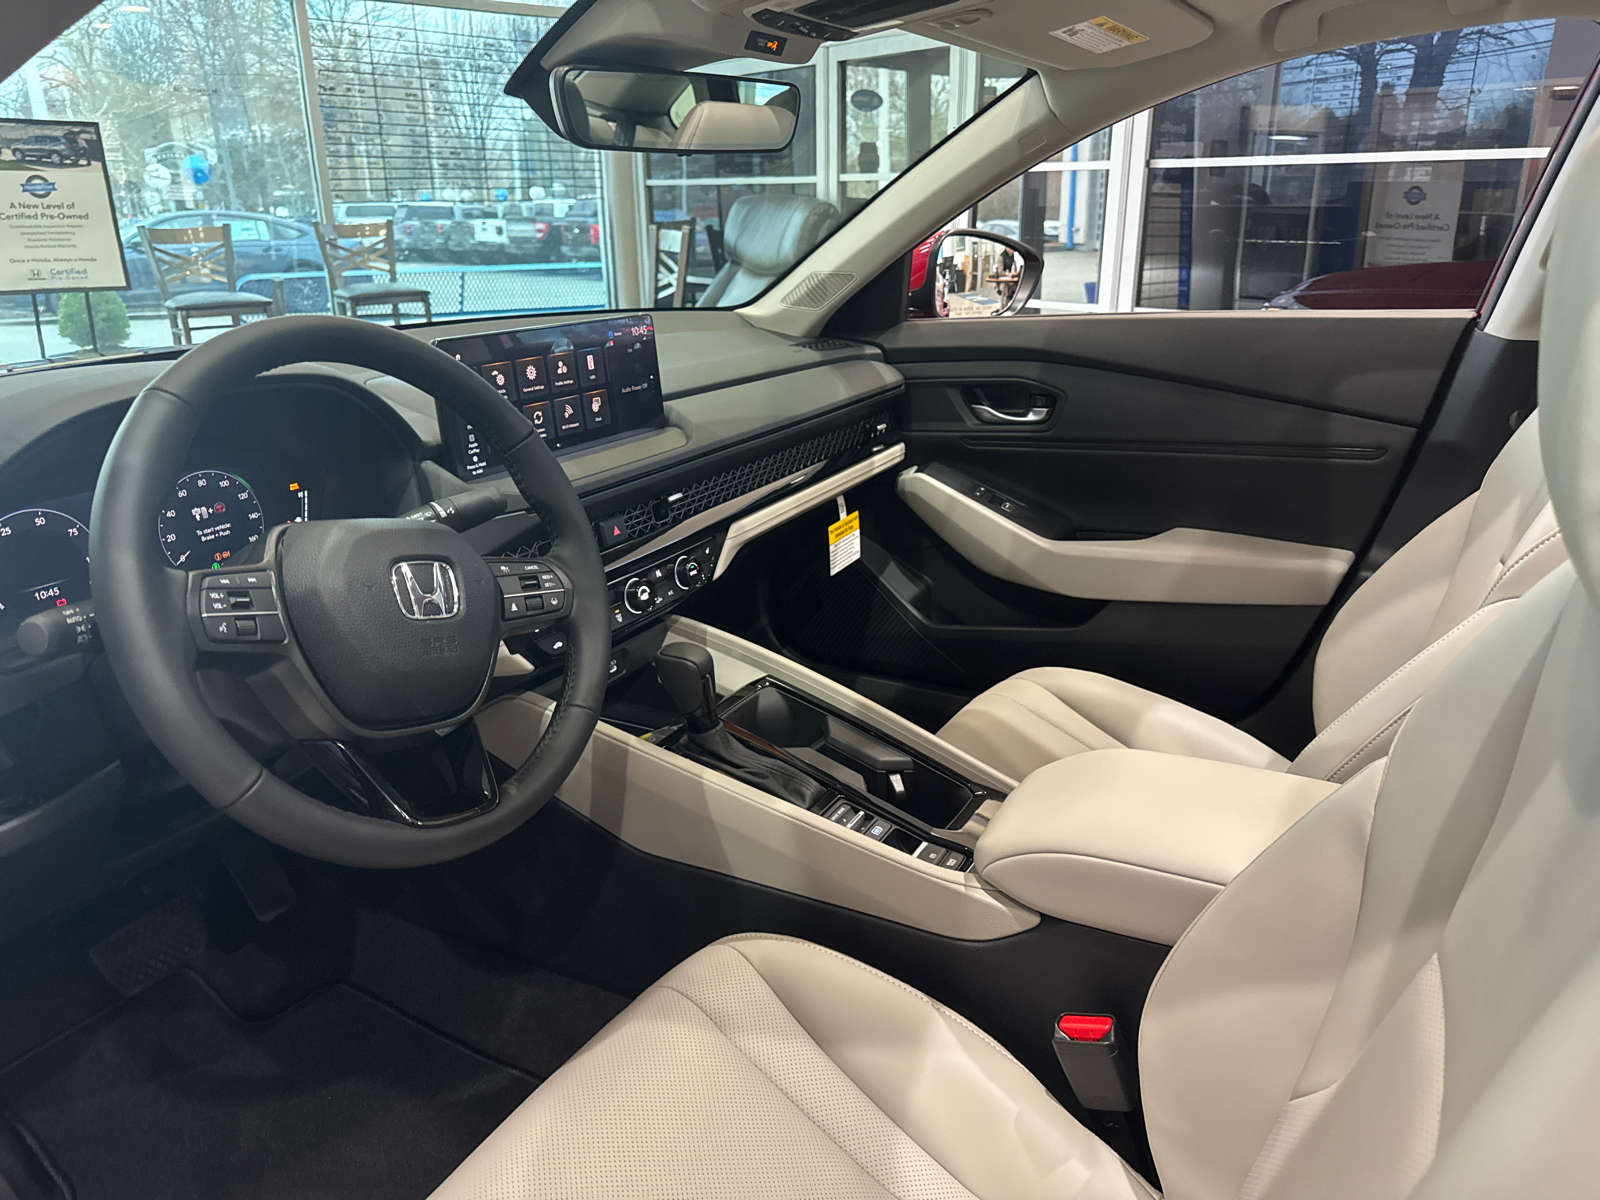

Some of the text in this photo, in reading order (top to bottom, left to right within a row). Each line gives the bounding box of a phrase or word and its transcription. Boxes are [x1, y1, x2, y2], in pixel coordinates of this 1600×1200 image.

[9, 201, 75, 210] A New Level of
[0, 212, 90, 220] Certified Pre-Owned
[50, 268, 88, 276] Certified
[631, 325, 648, 337] 10:45
[622, 386, 632, 394] Audio
[631, 384, 642, 392] Power
[197, 479, 207, 487] 80
[219, 480, 230, 488] 100
[178, 489, 187, 498] 60
[238, 492, 249, 500] 120
[166, 510, 176, 518] 40
[248, 512, 259, 520] 140
[35, 516, 46, 526] 50
[0, 527, 12, 536] 25
[67, 527, 79, 537] 75
[203, 526, 214, 534] start
[214, 522, 232, 531] vehicle:
[166, 533, 176, 542] 20
[201, 534, 215, 542] Brake
[34, 586, 60, 601] 10:45
[66, 615, 83, 624] AUTO
